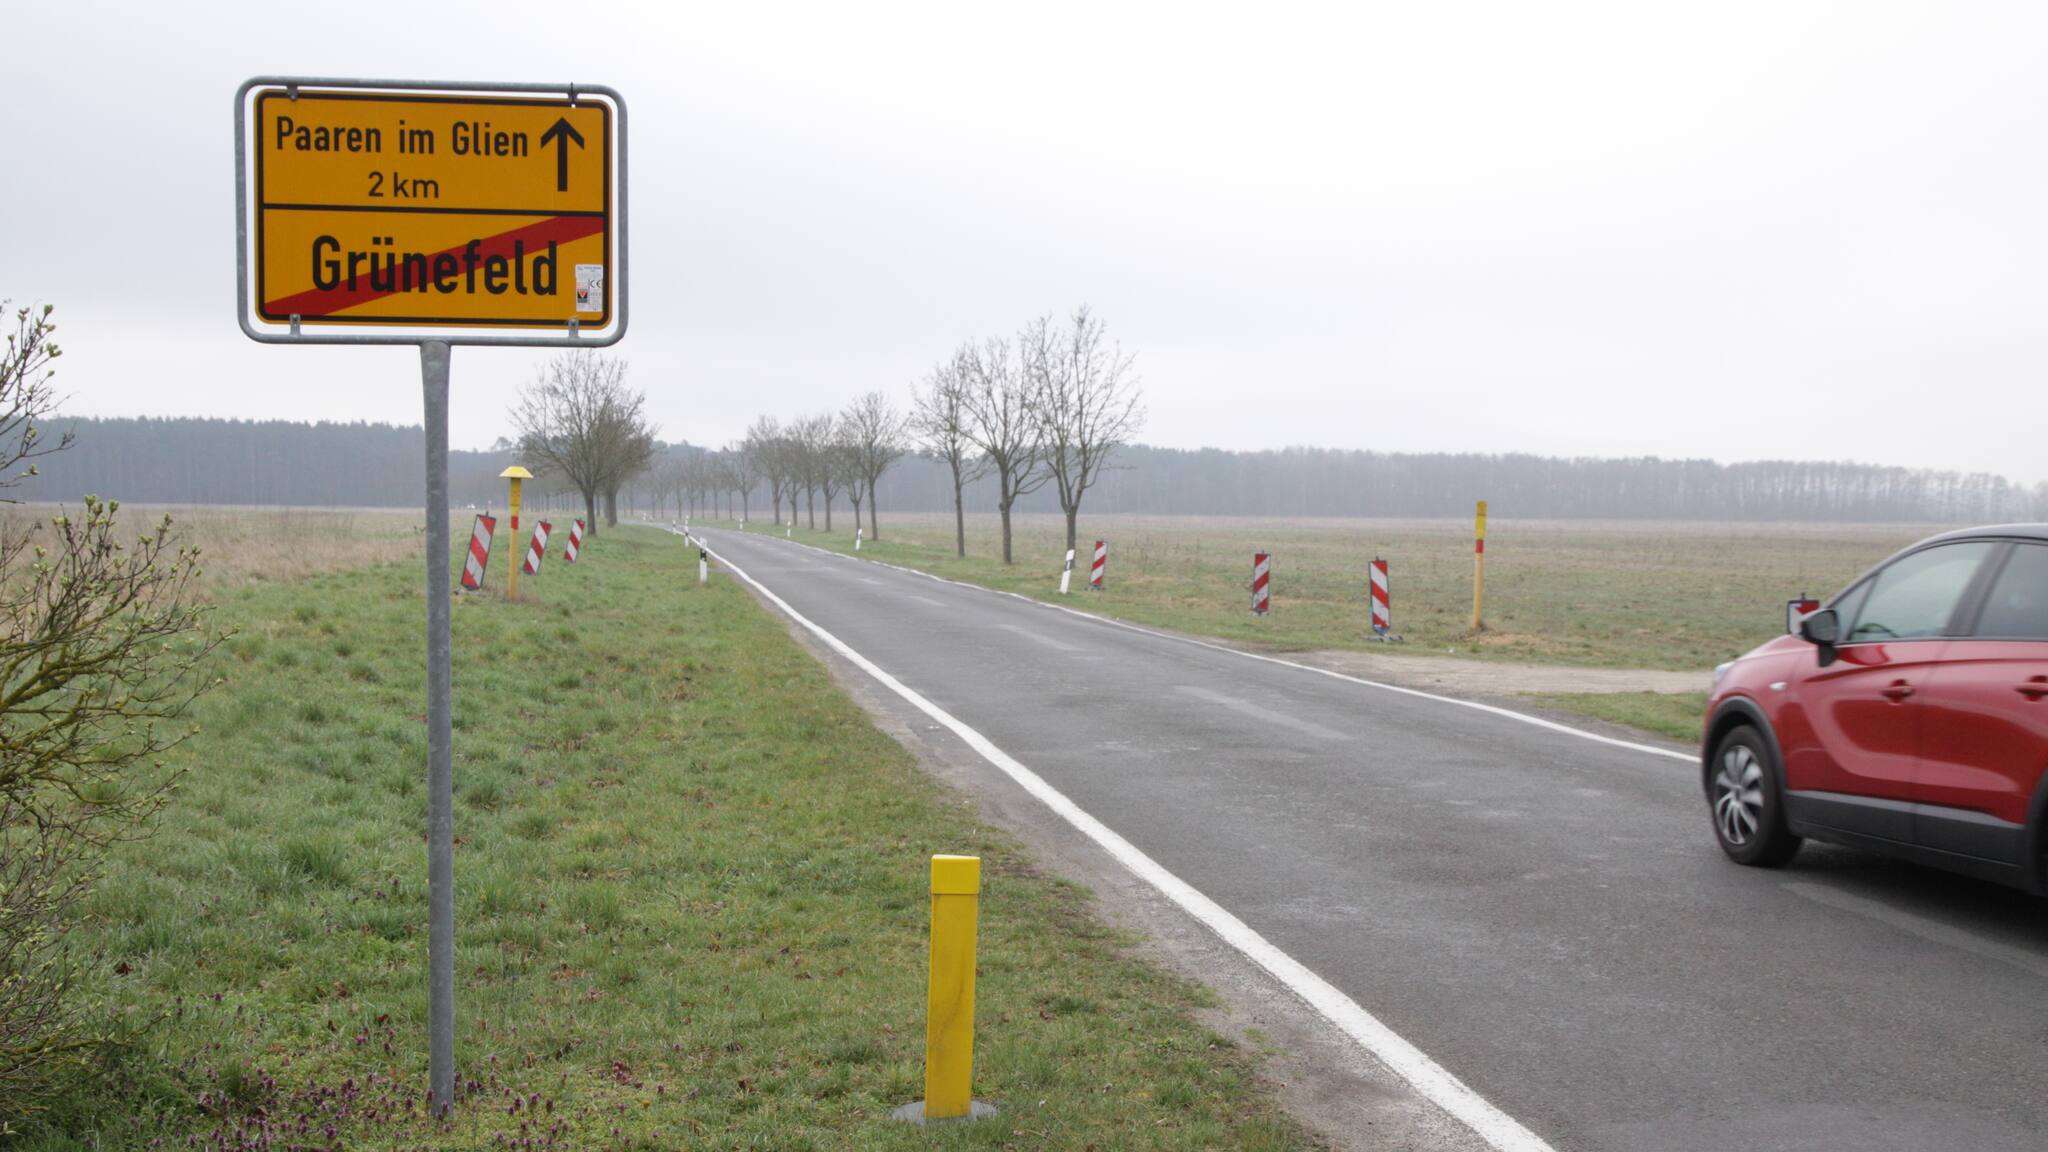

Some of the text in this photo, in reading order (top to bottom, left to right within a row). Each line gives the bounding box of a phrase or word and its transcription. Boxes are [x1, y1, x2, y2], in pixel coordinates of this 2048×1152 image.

[276, 116, 529, 157] Paaren im Glien
[368, 171, 439, 198] 2 km
[312, 235, 558, 296] Grünefeld
